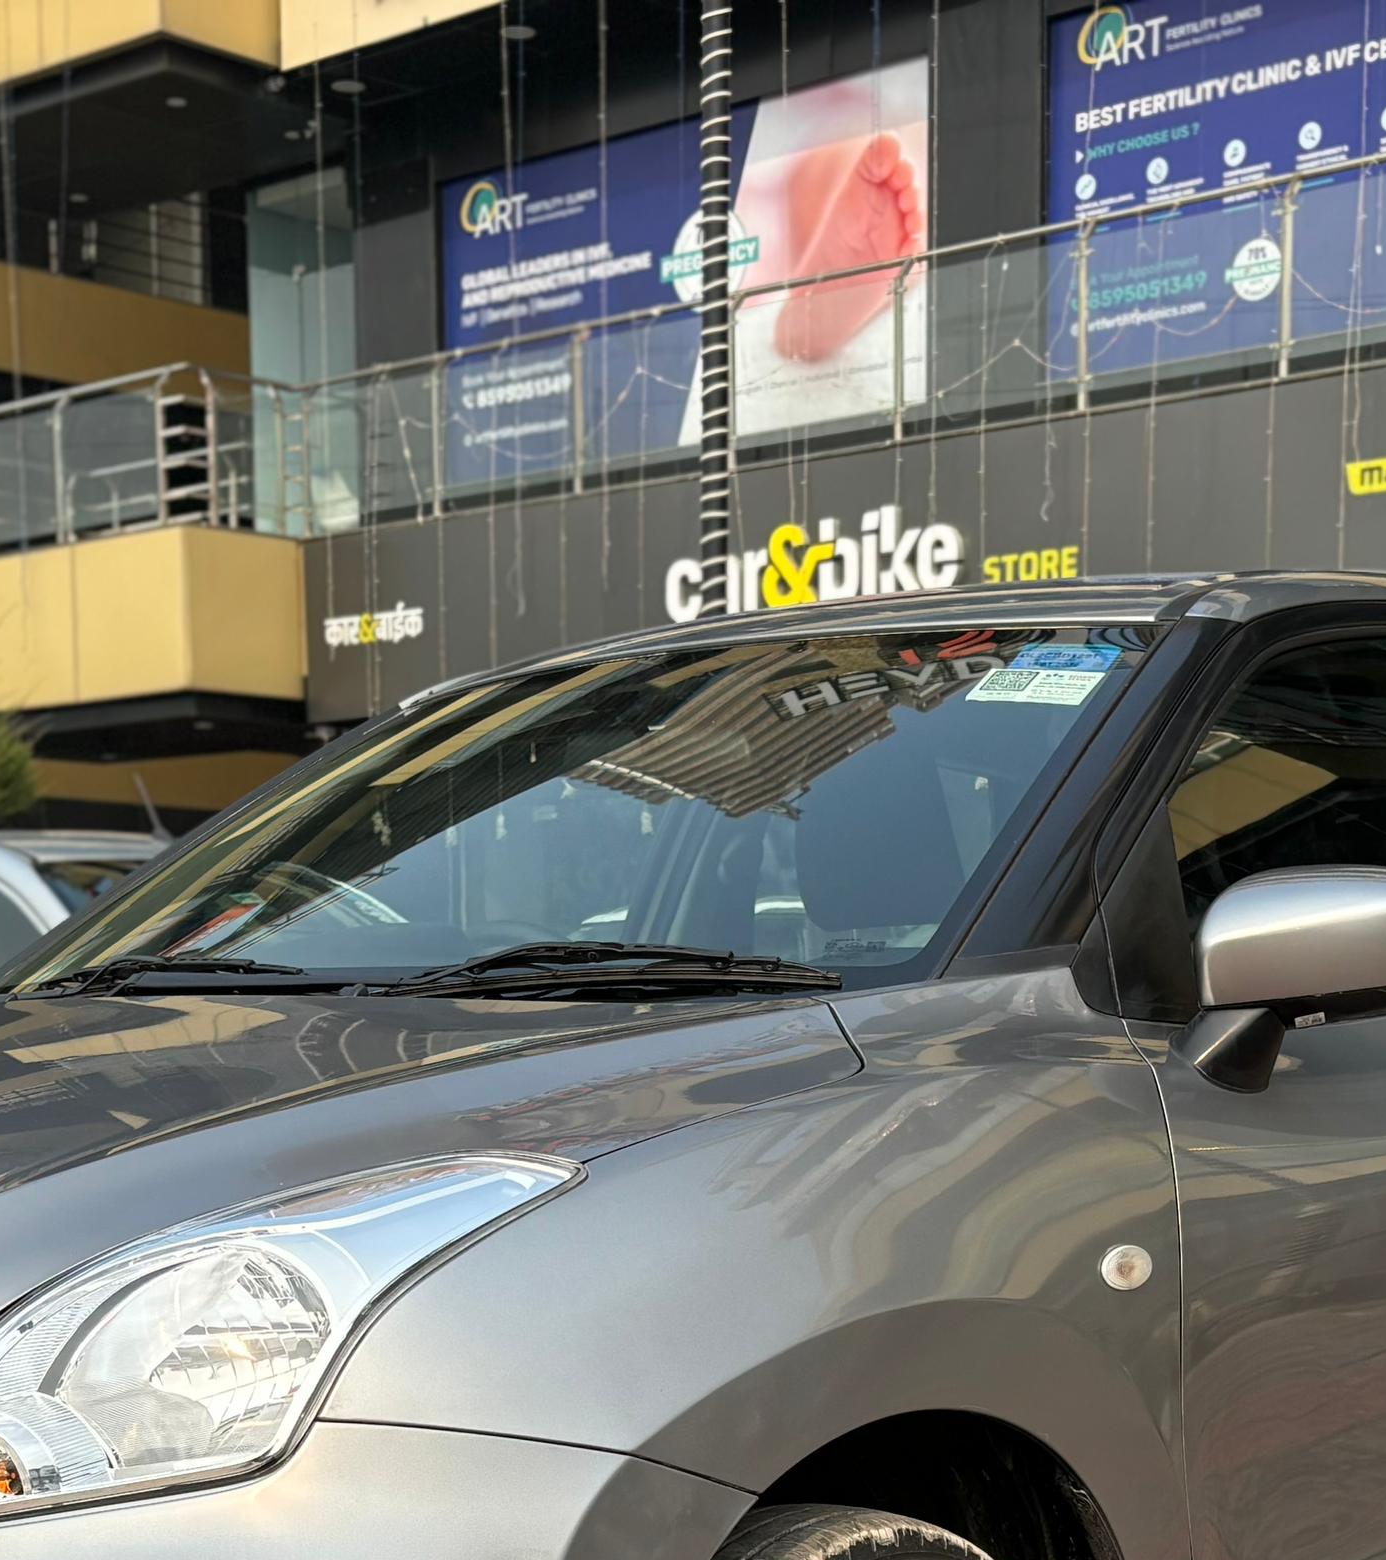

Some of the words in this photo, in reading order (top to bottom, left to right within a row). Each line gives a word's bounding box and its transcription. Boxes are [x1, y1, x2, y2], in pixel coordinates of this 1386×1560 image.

[1166, 17, 1217, 40] FERTILITY
[1219, 4, 1262, 27] CLINICS
[1095, 16, 1168, 71] ART
[1075, 102, 1126, 133] BEST
[1128, 76, 1231, 120] FERTILITY
[1231, 58, 1302, 94] CLINIC
[1305, 54, 1322, 77] &
[1324, 44, 1363, 73] IVF
[1088, 143, 1115, 161] WHY
[1116, 129, 1170, 154] CHOOSE
[1170, 123, 1190, 140] US
[1192, 122, 1201, 136] ?
[474, 193, 529, 239] ART
[983, 545, 1080, 583] STORE
